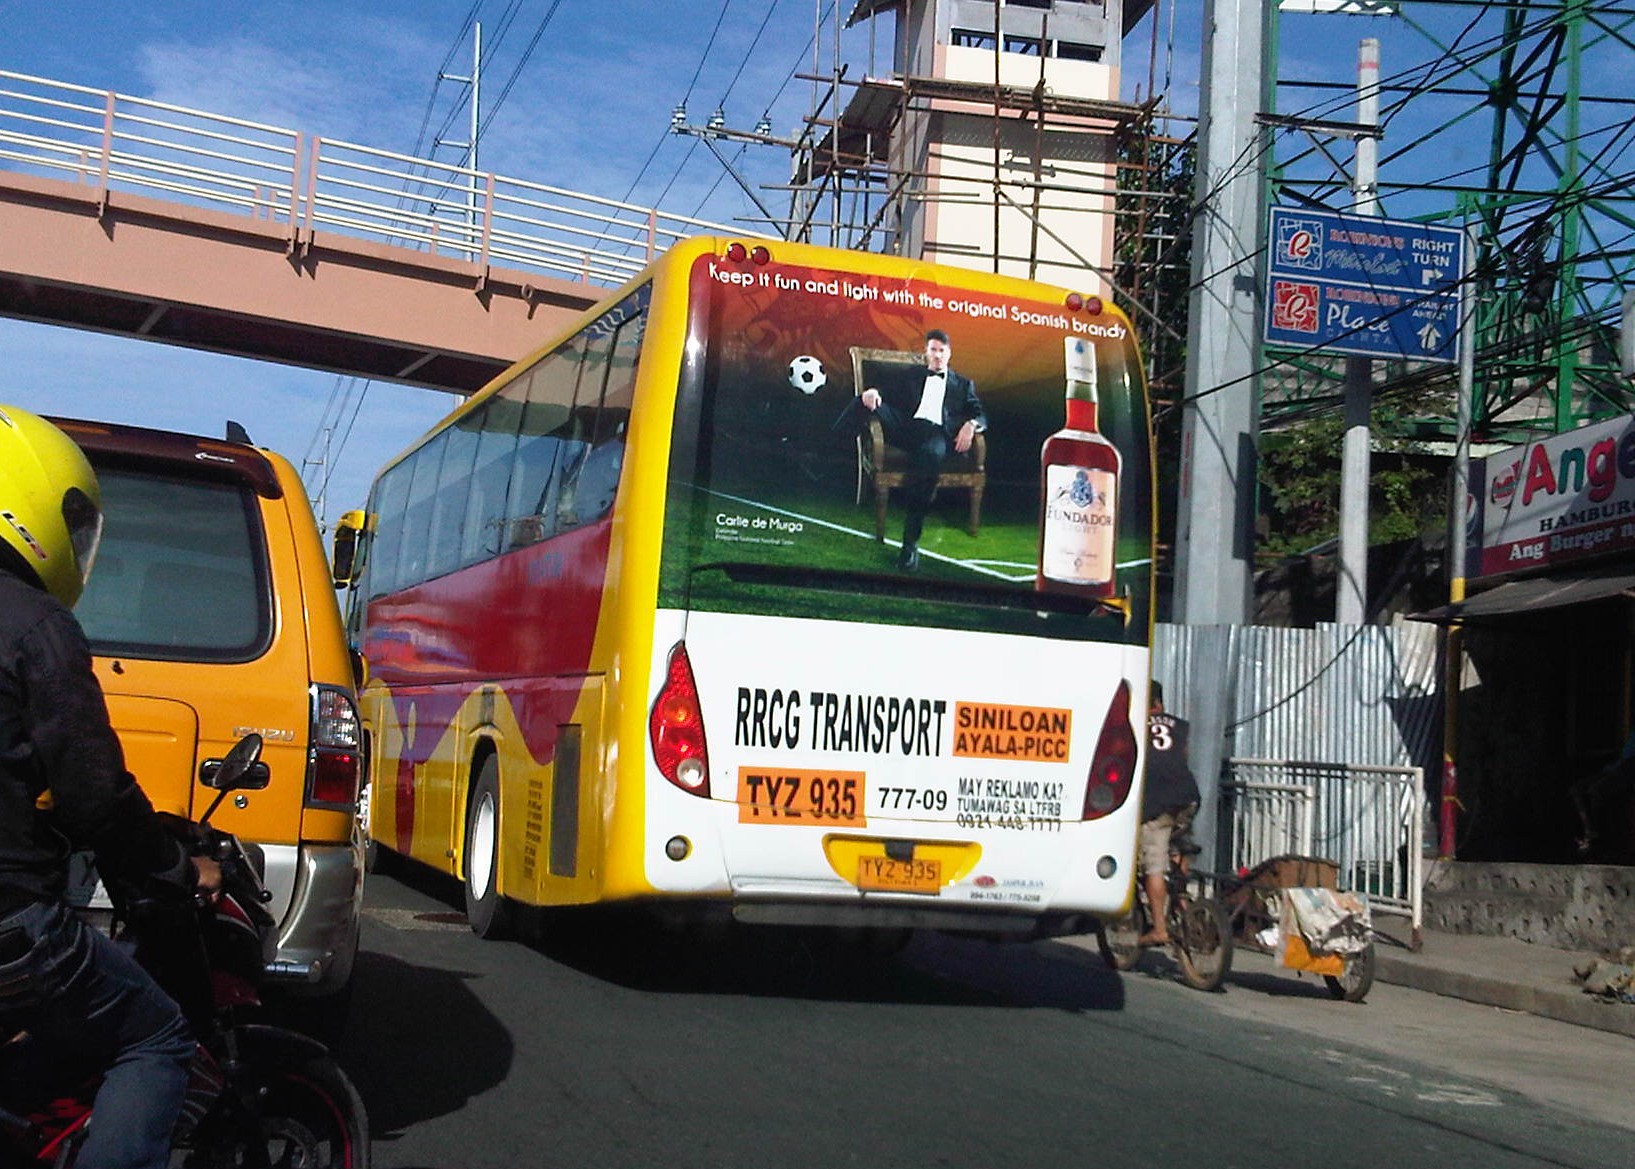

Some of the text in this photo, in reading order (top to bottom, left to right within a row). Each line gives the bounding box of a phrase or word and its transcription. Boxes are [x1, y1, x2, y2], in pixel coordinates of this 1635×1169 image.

[1412, 238, 1455, 253] RIGHT
[1412, 253, 1450, 267] TURN
[708, 262, 754, 287] Keep
[774, 273, 800, 291] fun
[805, 279, 838, 295] and
[843, 282, 878, 301] light
[883, 288, 914, 305] with
[918, 294, 943, 309] the
[948, 300, 1007, 319] original
[1011, 306, 1069, 330] Spanish
[1072, 317, 1127, 340] brandy
[1326, 302, 1390, 333] Place
[751, 517, 767, 529] de
[769, 517, 803, 533] Murga
[1047, 505, 1112, 526] FUNDADOR
[1539, 500, 1635, 532] HAMBUR
[1509, 541, 1544, 561] Ang
[1550, 527, 1614, 552] Burger
[735, 687, 947, 757] RRCG TRANSPORT
[958, 706, 1067, 734] SINILOAN
[956, 732, 1066, 758] AYALA-PICC
[1151, 724, 1173, 750] 3
[746, 775, 857, 820] TYZ 935
[878, 787, 948, 811] 777-09
[958, 777, 1064, 800] MAY REKLAMO KA?
[957, 798, 1061, 816] TUMAWAG SA LTFRB
[865, 859, 936, 880] TYZ 935
